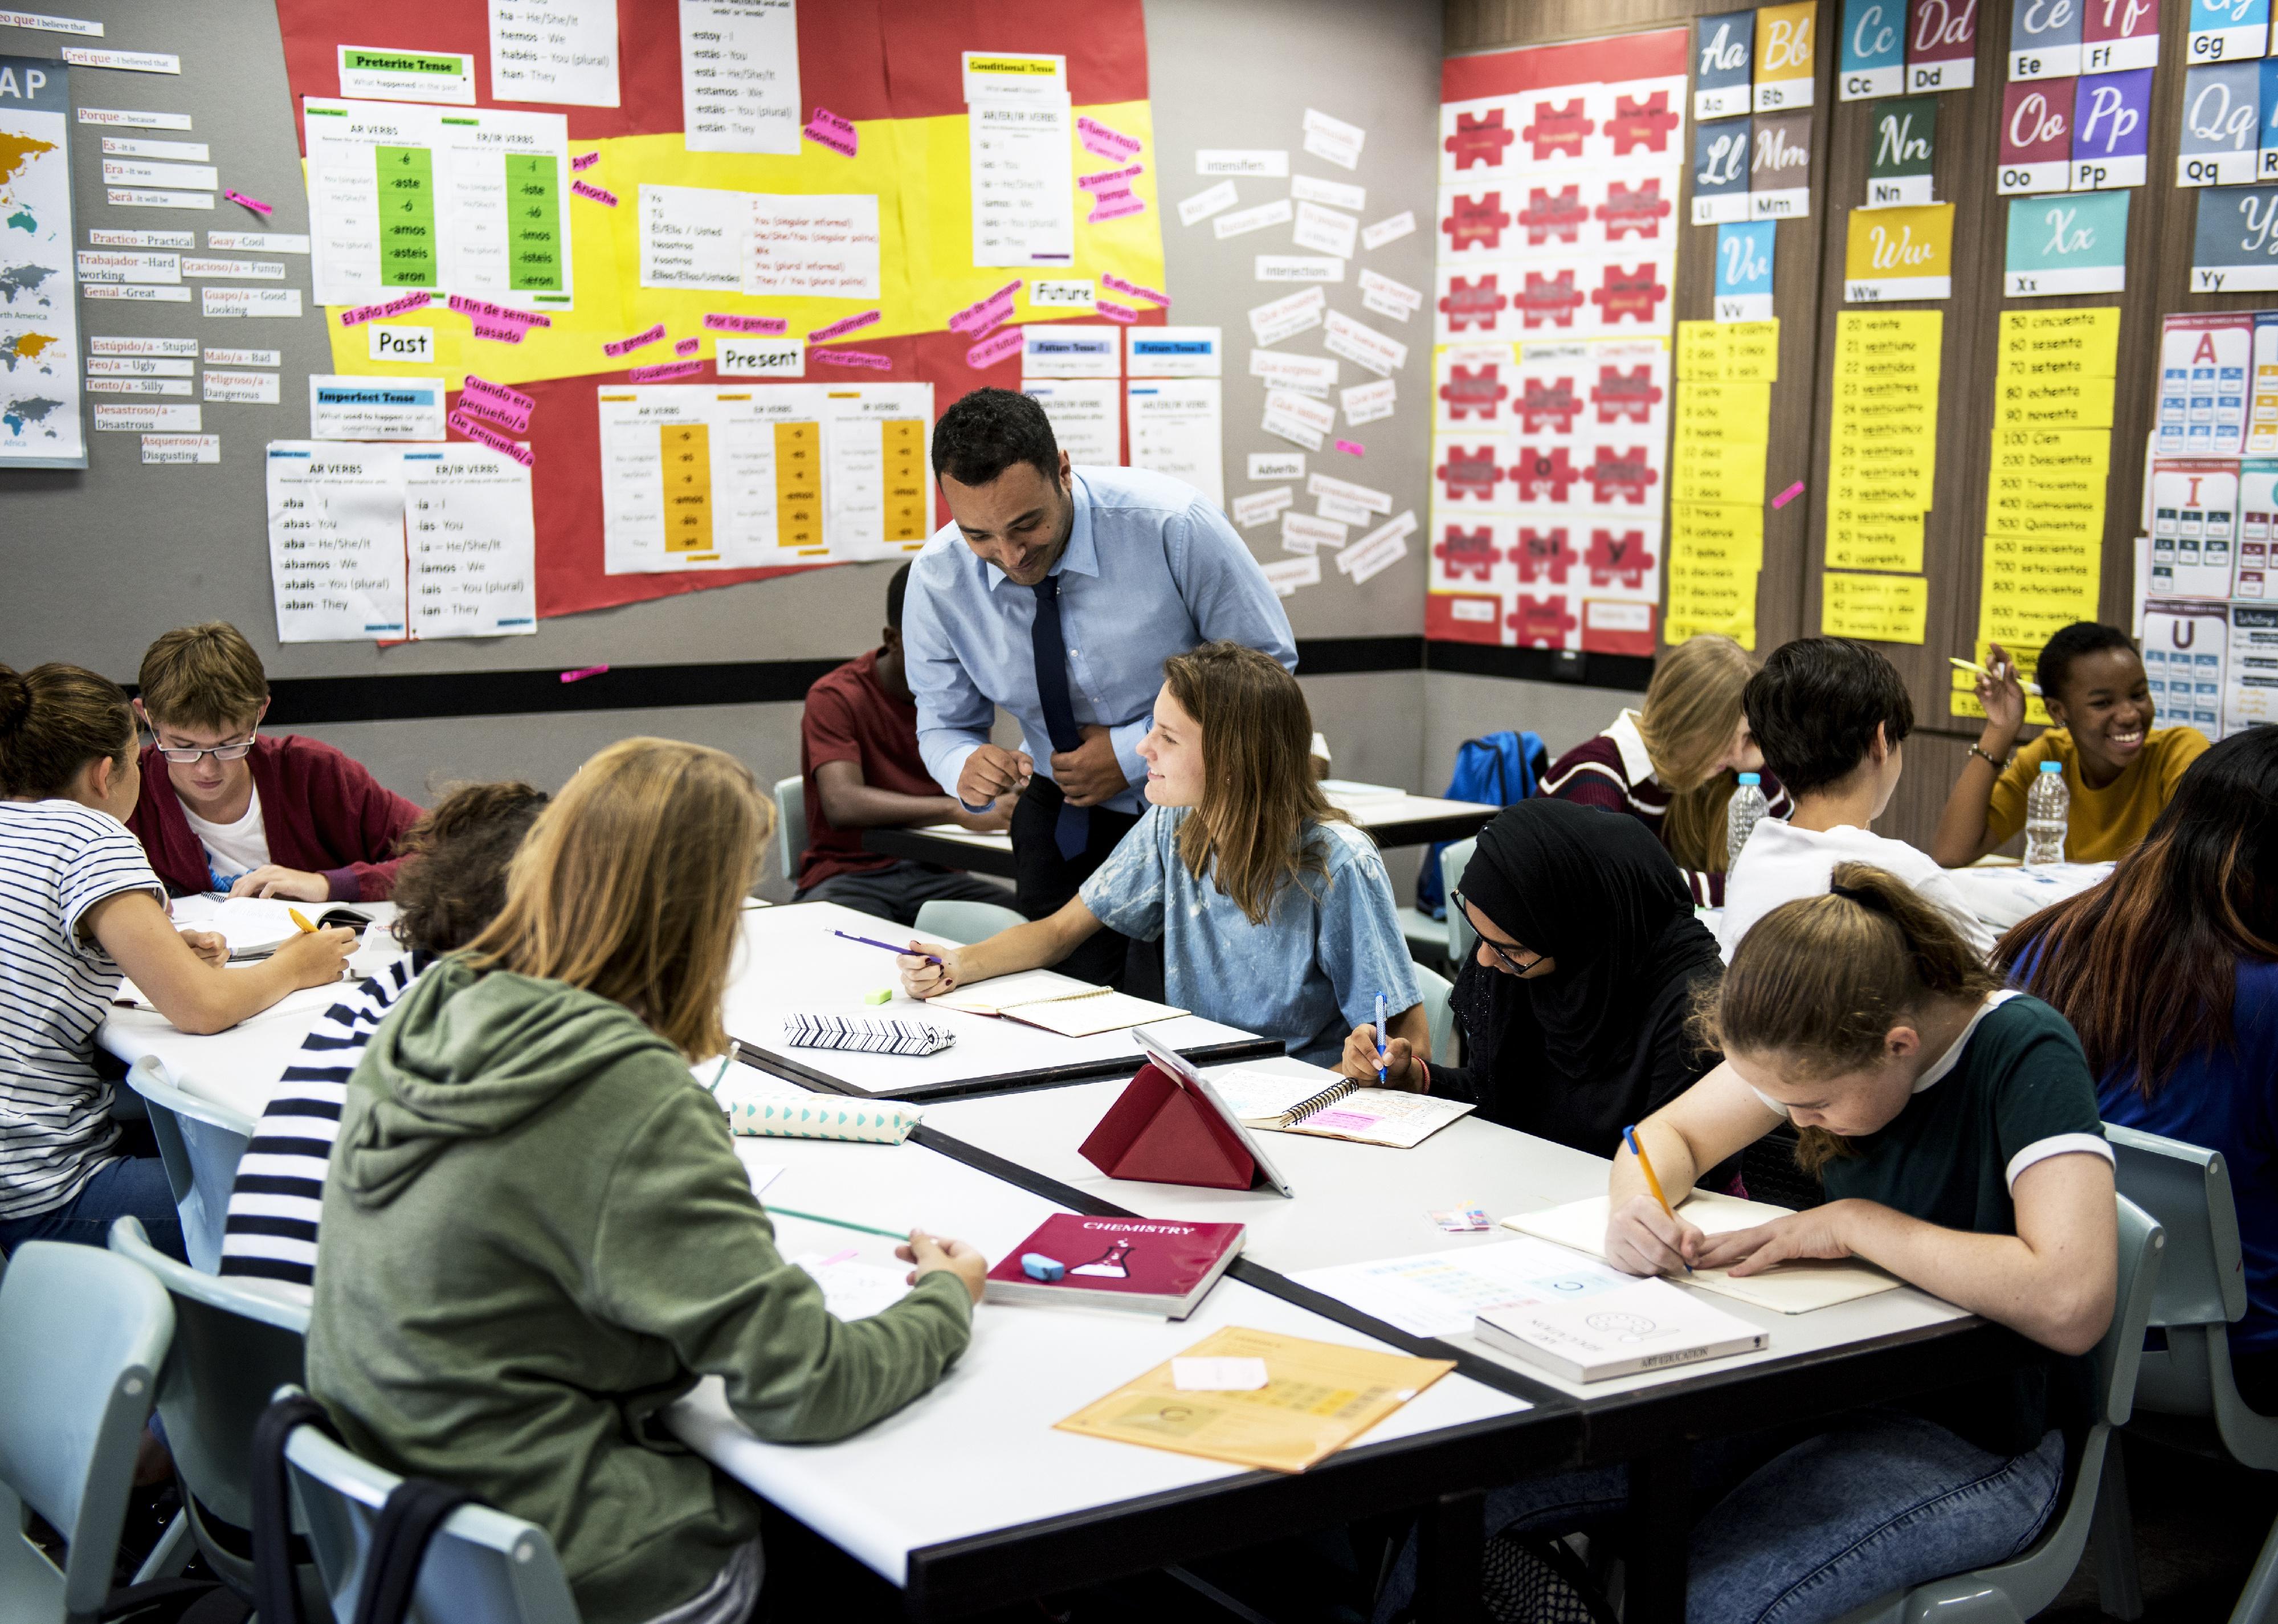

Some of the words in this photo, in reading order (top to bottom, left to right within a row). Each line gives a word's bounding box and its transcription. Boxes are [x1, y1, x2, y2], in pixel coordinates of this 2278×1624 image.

[14, 17, 35, 27] que
[42, 19, 68, 29] believe
[71, 22, 85, 31] that
[1914, 0, 1977, 51] Dd
[1854, 6, 1896, 58] Cc
[1700, 23, 1749, 75] Aa
[1764, 18, 1812, 70] Bb
[2194, 36, 2224, 58] Gg
[91, 54, 111, 64] que
[356, 56, 414, 70] Preterite
[417, 60, 452, 71] Tense
[2092, 48, 2110, 67] Ff
[2018, 57, 2040, 74] Ee
[1848, 77, 1872, 94] Cc
[1915, 70, 1941, 87] Dd
[1762, 88, 1782, 104] Bb
[80, 109, 119, 123] Porque
[2010, 93, 2066, 147] Oo
[2082, 87, 2139, 152] Pp
[2189, 83, 2256, 150] Qq
[103, 140, 115, 150] Es
[1876, 113, 1933, 166] Nn
[1753, 129, 1808, 173] Mm
[573, 153, 598, 170] Ayer
[1697, 133, 1746, 185] Ll
[105, 164, 123, 174] Era
[2187, 161, 2218, 185] Qq
[2003, 170, 2030, 185] Oo
[2081, 165, 2106, 190] Pp
[108, 191, 132, 202] Será
[572, 180, 618, 206] Anoche
[1876, 186, 1900, 202] Nn
[1758, 199, 1790, 213] Mm
[2042, 208, 2095, 254] Xx
[93, 233, 137, 244] Practico
[148, 236, 193, 247] Practical
[1871, 225, 1934, 268] Ww
[79, 254, 138, 268] Trabajador
[182, 260, 240, 272] Gracioso/a
[252, 264, 283, 276] Funny
[1724, 237, 1769, 285] Vv
[79, 270, 124, 283] working
[2017, 277, 2037, 291] Xx
[2202, 272, 2224, 292] Yy
[85, 287, 119, 297] Genial
[205, 291, 250, 302] Guapo/a
[261, 291, 287, 300] Good
[1037, 284, 1090, 300] Future
[1853, 287, 1880, 301] Ww
[206, 304, 247, 317] Looking
[342, 311, 353, 325] El
[359, 307, 382, 321] año
[385, 292, 430, 317] pasado
[450, 296, 460, 308] El
[464, 299, 480, 312] fin
[484, 304, 499, 315] de
[503, 308, 550, 327] semana
[1724, 303, 1743, 317] Vv
[707, 315, 725, 326] Por
[743, 319, 785, 331] general
[2011, 316, 2027, 329] 50
[2032, 315, 2096, 328] cincuenta
[475, 326, 520, 343] pasado
[163, 342, 196, 353] Stupid
[379, 332, 427, 353] Past
[2032, 338, 2081, 349] sesenta
[2193, 333, 2217, 364] A
[205, 352, 242, 362] Malo/a
[251, 353, 270, 362] Bad
[726, 350, 798, 368] Present
[88, 360, 120, 370] Feo/a
[133, 361, 156, 372] Ugly
[2032, 362, 2080, 373] setenta
[87, 380, 132, 392] Tonto/a
[141, 381, 164, 394] Silly
[205, 374, 263, 386] Peligroso/a
[205, 388, 259, 401] Dangerous
[320, 391, 379, 403] Imperfect
[382, 393, 415, 403] Tense
[466, 375, 509, 401] Cuando
[514, 397, 532, 409] era
[2028, 385, 2079, 398] ochenta
[97, 405, 168, 416] Desastroso/a
[459, 399, 525, 429] pequeño/a
[2027, 409, 2077, 421] noventa
[97, 419, 154, 429] Disastrous
[142, 435, 209, 447] Asqueroso/a
[451, 413, 467, 427] De
[470, 426, 532, 464] pequeño/a
[2004, 432, 2027, 446] 100
[2033, 430, 2060, 444] Cien
[144, 451, 198, 463] Disgusting
[310, 464, 324, 474] AR
[328, 464, 362, 475] VERBS
[467, 464, 499, 474] VERBS
[2186, 478, 2203, 507] I
[319, 520, 337, 529] You
[341, 560, 358, 568] We
[329, 580, 347, 590] You
[322, 599, 348, 612] They
[2173, 620, 2194, 649] U
[1083, 1222, 1195, 1234] CHEMISTRY
[1640, 1356, 1657, 1369] ART
[1659, 1346, 1708, 1364] EDUCATION
